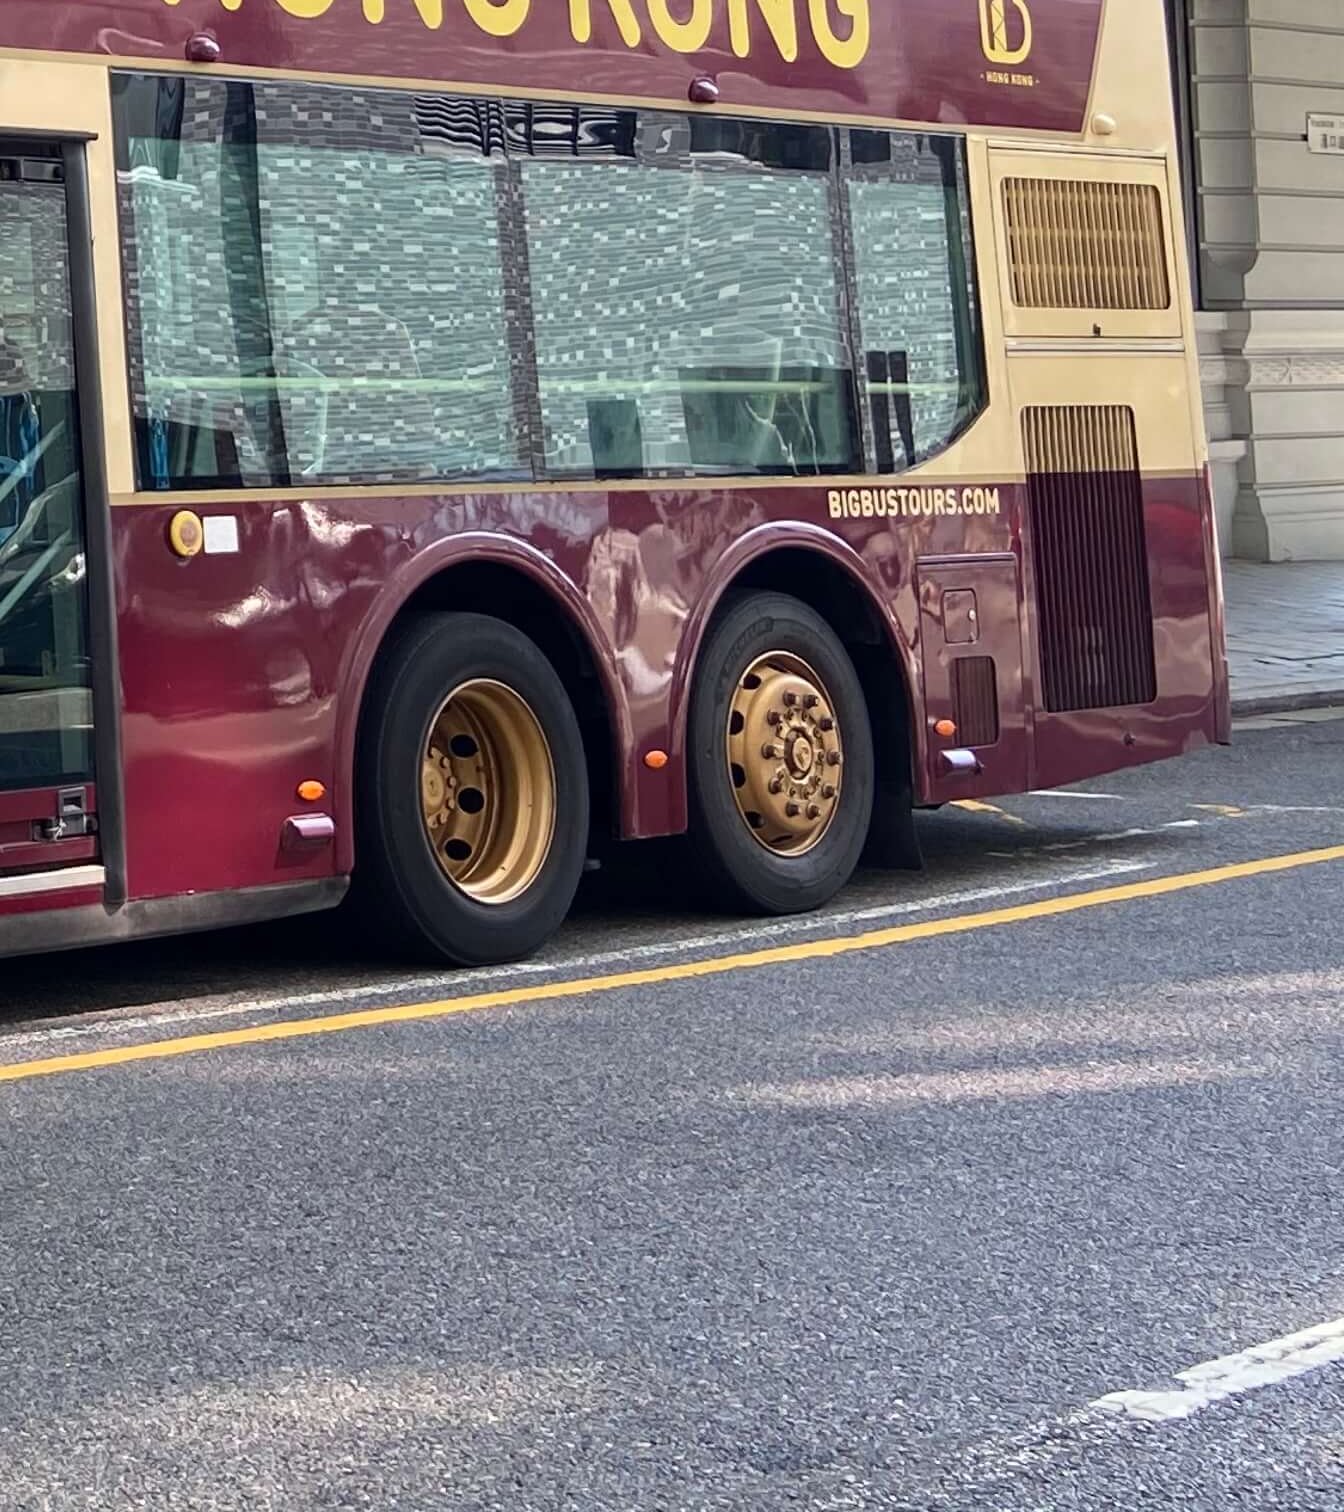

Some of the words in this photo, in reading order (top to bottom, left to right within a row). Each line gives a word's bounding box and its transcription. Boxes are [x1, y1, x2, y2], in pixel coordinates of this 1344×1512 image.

[985, 71, 1009, 84] HONG
[1011, 73, 1034, 86] KONG
[827, 488, 1001, 518] BIGBUSTOURS.COM
